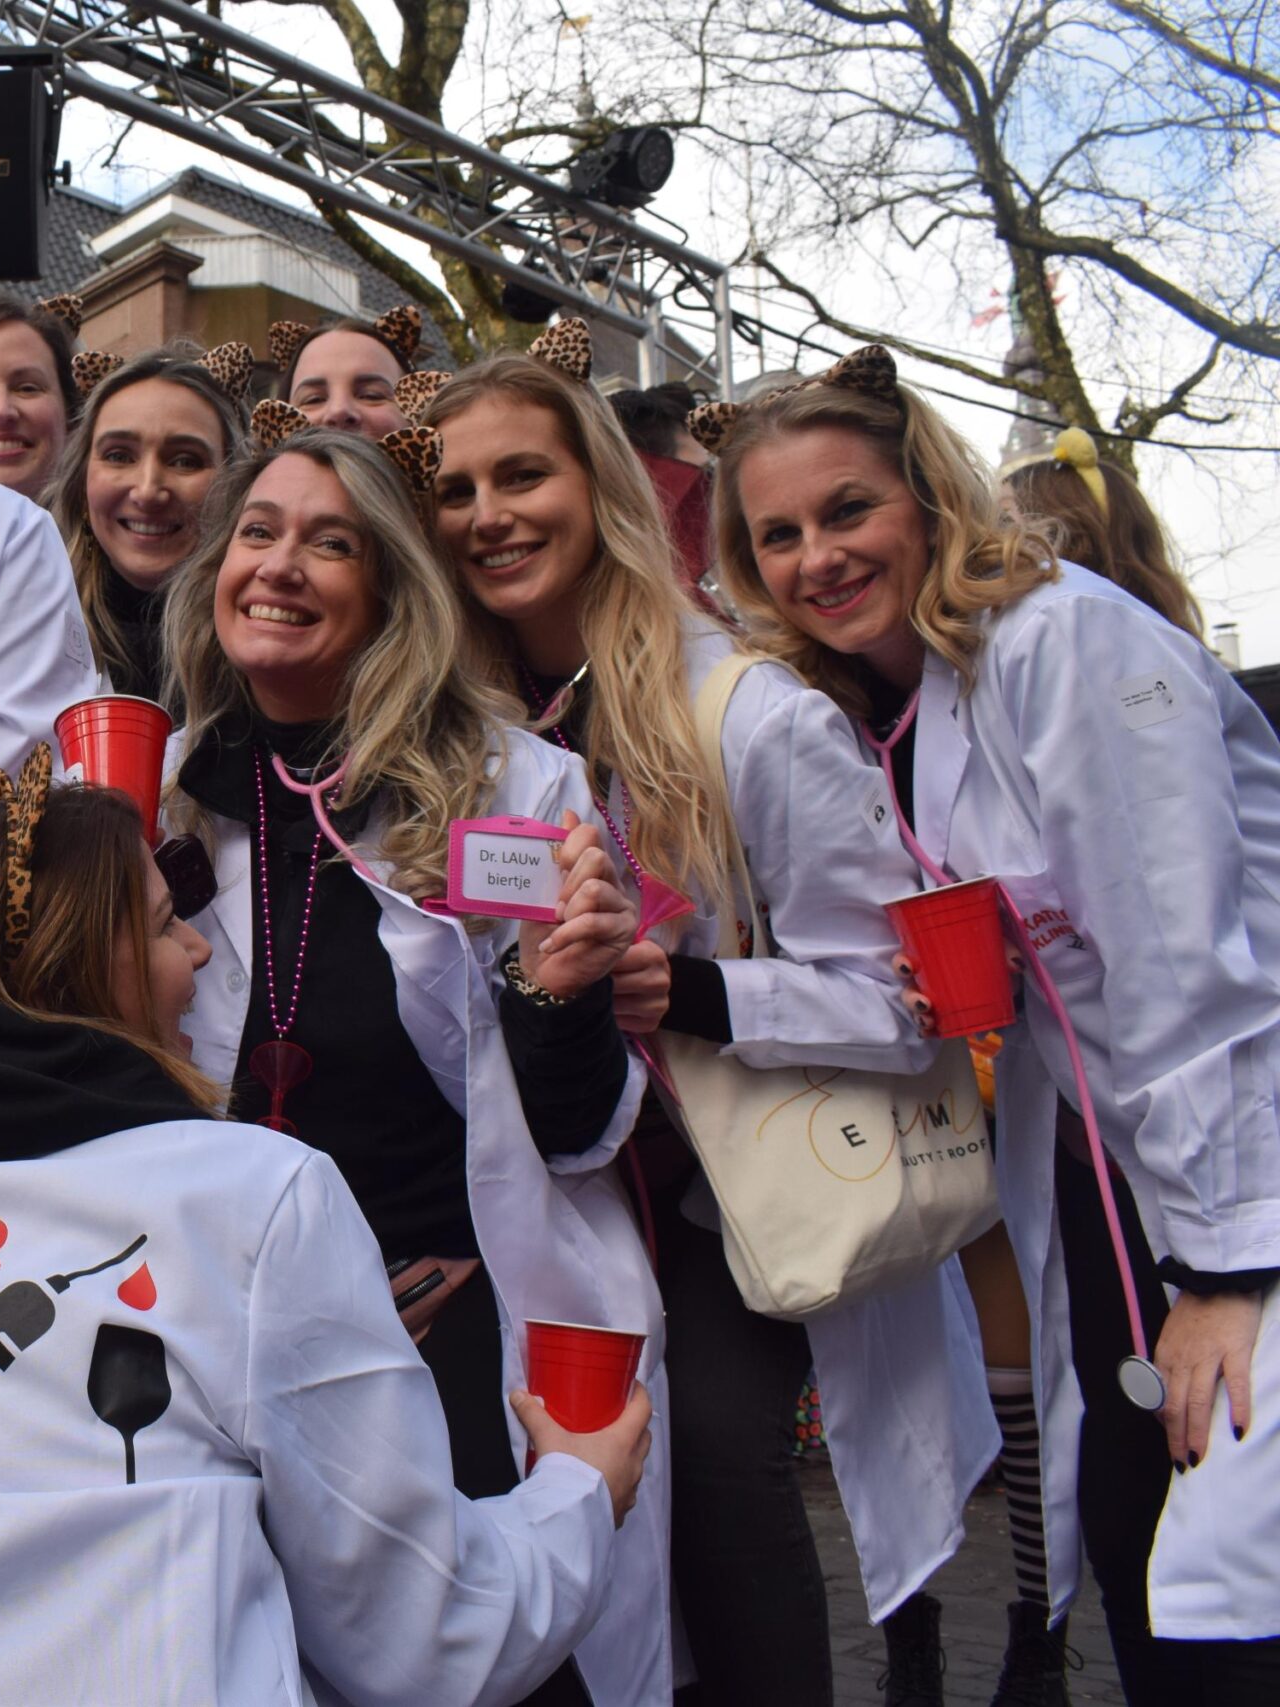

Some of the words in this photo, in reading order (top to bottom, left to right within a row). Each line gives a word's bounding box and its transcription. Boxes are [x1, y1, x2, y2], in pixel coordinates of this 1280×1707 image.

[480, 849, 498, 863] Dr.
[502, 851, 541, 866] LAUw
[488, 872, 531, 890] biertje
